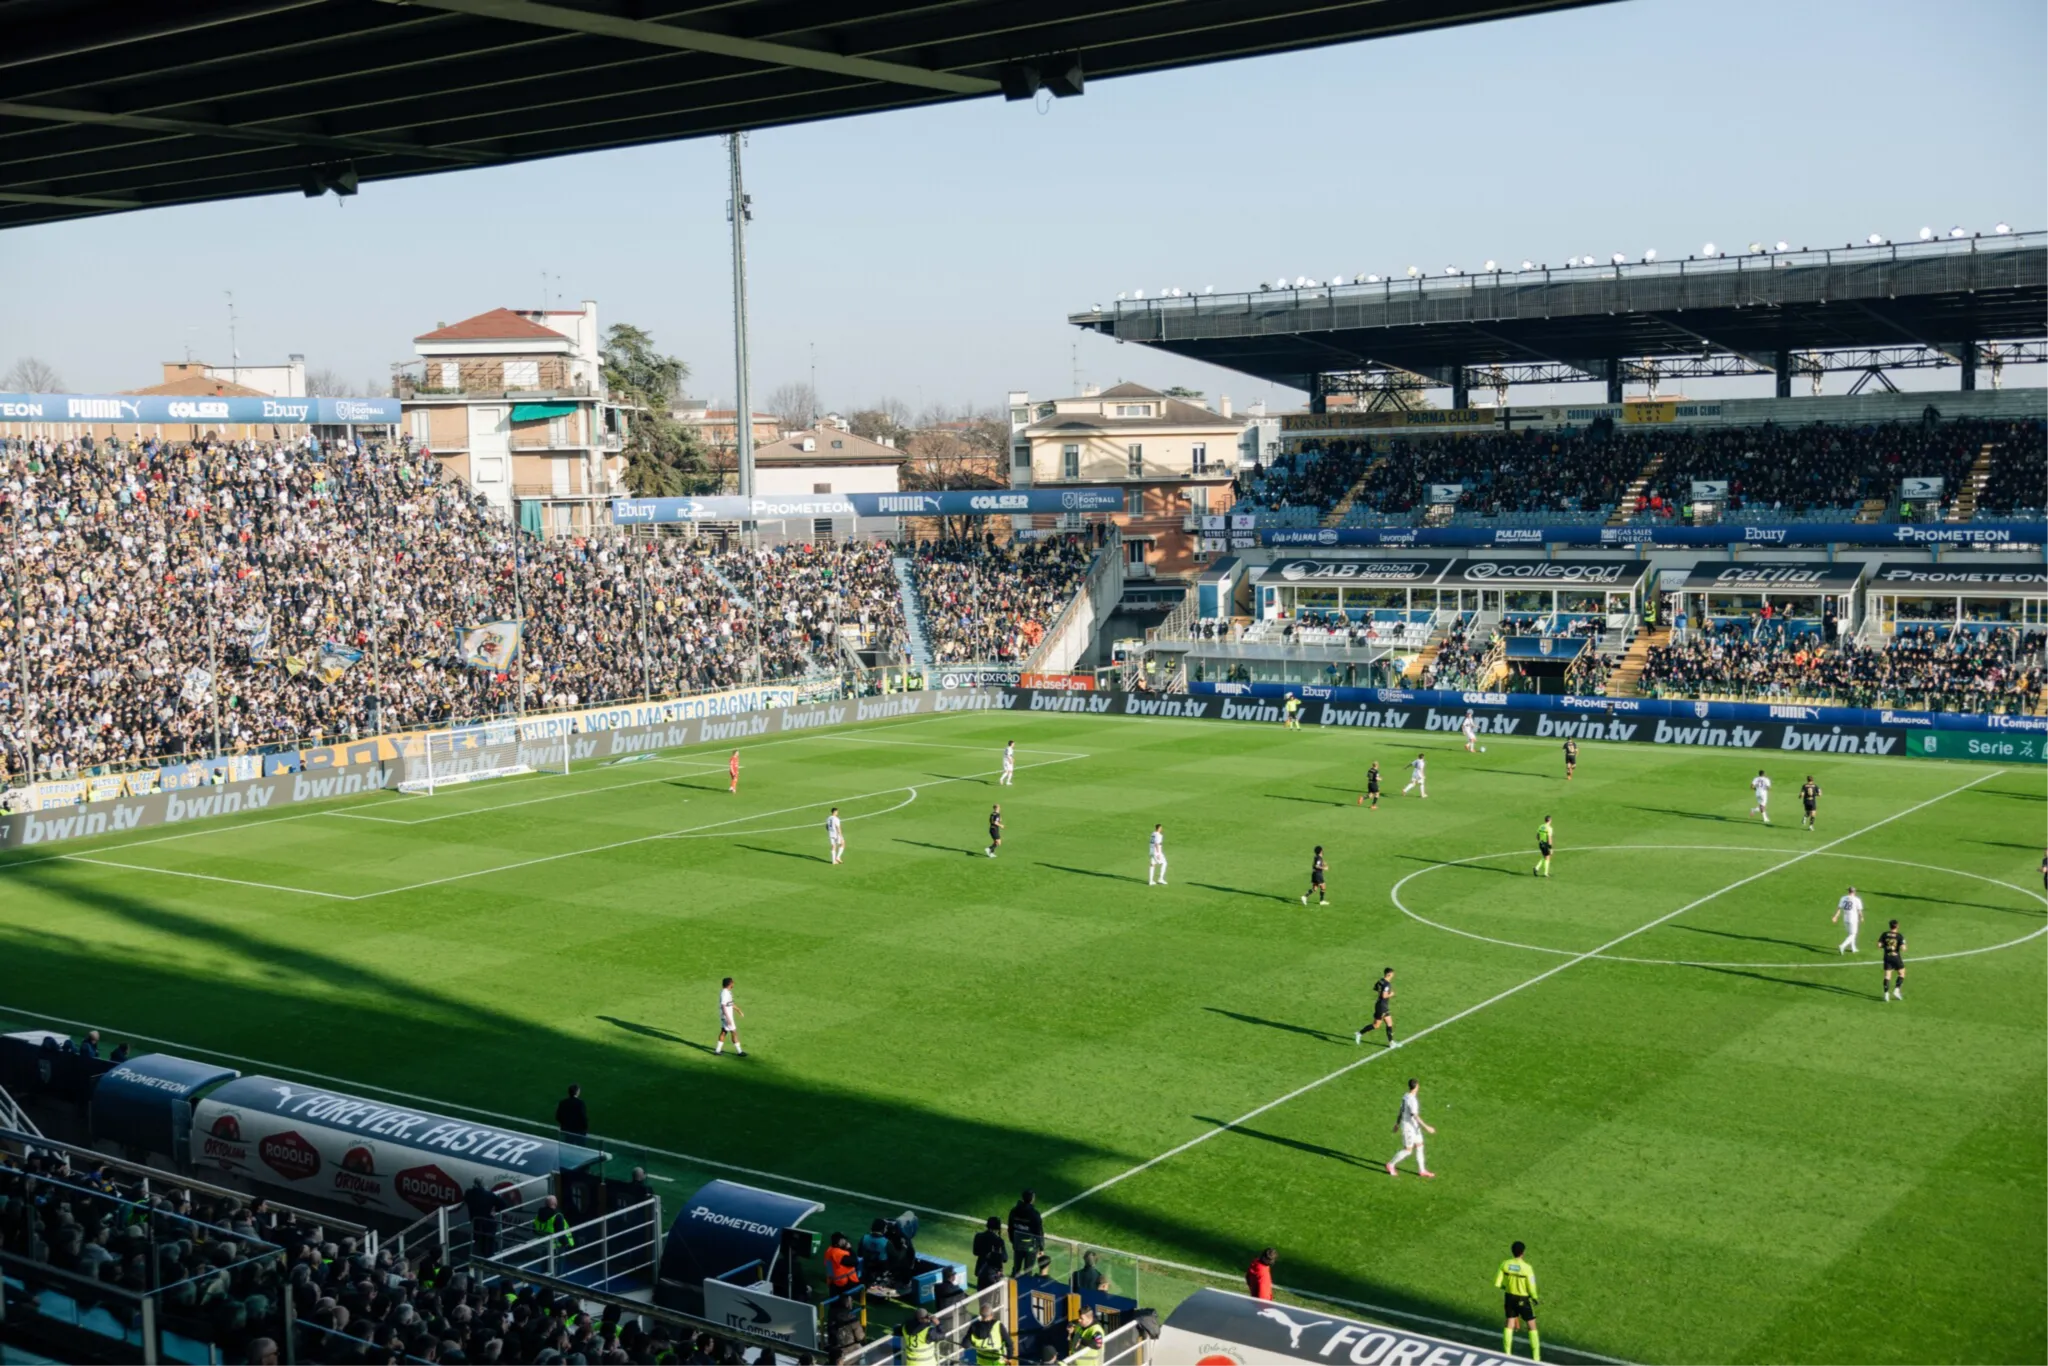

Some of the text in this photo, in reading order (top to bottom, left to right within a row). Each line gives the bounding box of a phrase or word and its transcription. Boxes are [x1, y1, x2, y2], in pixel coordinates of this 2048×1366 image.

[68, 398, 121, 418] PUMA
[168, 402, 229, 418] COLSER
[262, 400, 309, 419] Ebury
[1407, 413, 1446, 424] PARMA
[1448, 410, 1479, 423] CLUB
[1675, 406, 1698, 417] PARMA
[617, 501, 655, 519] Ebury
[751, 499, 855, 515] PROMETEON
[878, 495, 924, 512] PUMA
[970, 494, 1028, 509] COLSER
[1745, 527, 1786, 543] Ebury
[1894, 527, 2010, 541] PROMETEON
[1315, 565, 1359, 577] AB
[1496, 563, 1626, 579] callegari
[1717, 568, 1831, 581] Cetilar
[1882, 570, 2048, 582] PROMETEON
[960, 673, 1020, 684] IVY OXFORD
[1030, 677, 1087, 690] LeasePlan
[1215, 683, 1242, 694] PUMA
[1302, 686, 1331, 699] Ebury
[1463, 692, 1507, 704] COLSER
[857, 694, 920, 721] bwin.tv
[933, 688, 1018, 712] bwin.tv
[1030, 691, 1112, 712] bwin.tv
[1125, 694, 1208, 717] bwin.tv
[781, 701, 846, 731] bwin.tv
[1320, 703, 1410, 728] bwin.tv
[1770, 706, 1806, 718] PUMA
[700, 713, 770, 743] bwin.tv
[1536, 714, 1637, 741] bwin.tv
[1653, 719, 1762, 748] bwin.tv
[610, 726, 688, 755] bwin.tv
[1780, 726, 1898, 756] bwin.tv
[1968, 739, 2014, 755] Serie
[292, 768, 393, 802] bwin.tv
[165, 784, 275, 823] bwin.tv
[22, 802, 146, 844] bwin.tv
[111, 1066, 190, 1094] PROMETEON
[292, 1097, 542, 1166] FOREVER. FASTER.
[266, 1143, 315, 1166] RODOLFI
[402, 1177, 456, 1202] RODOLFI
[690, 1206, 778, 1238] PROMETEON
